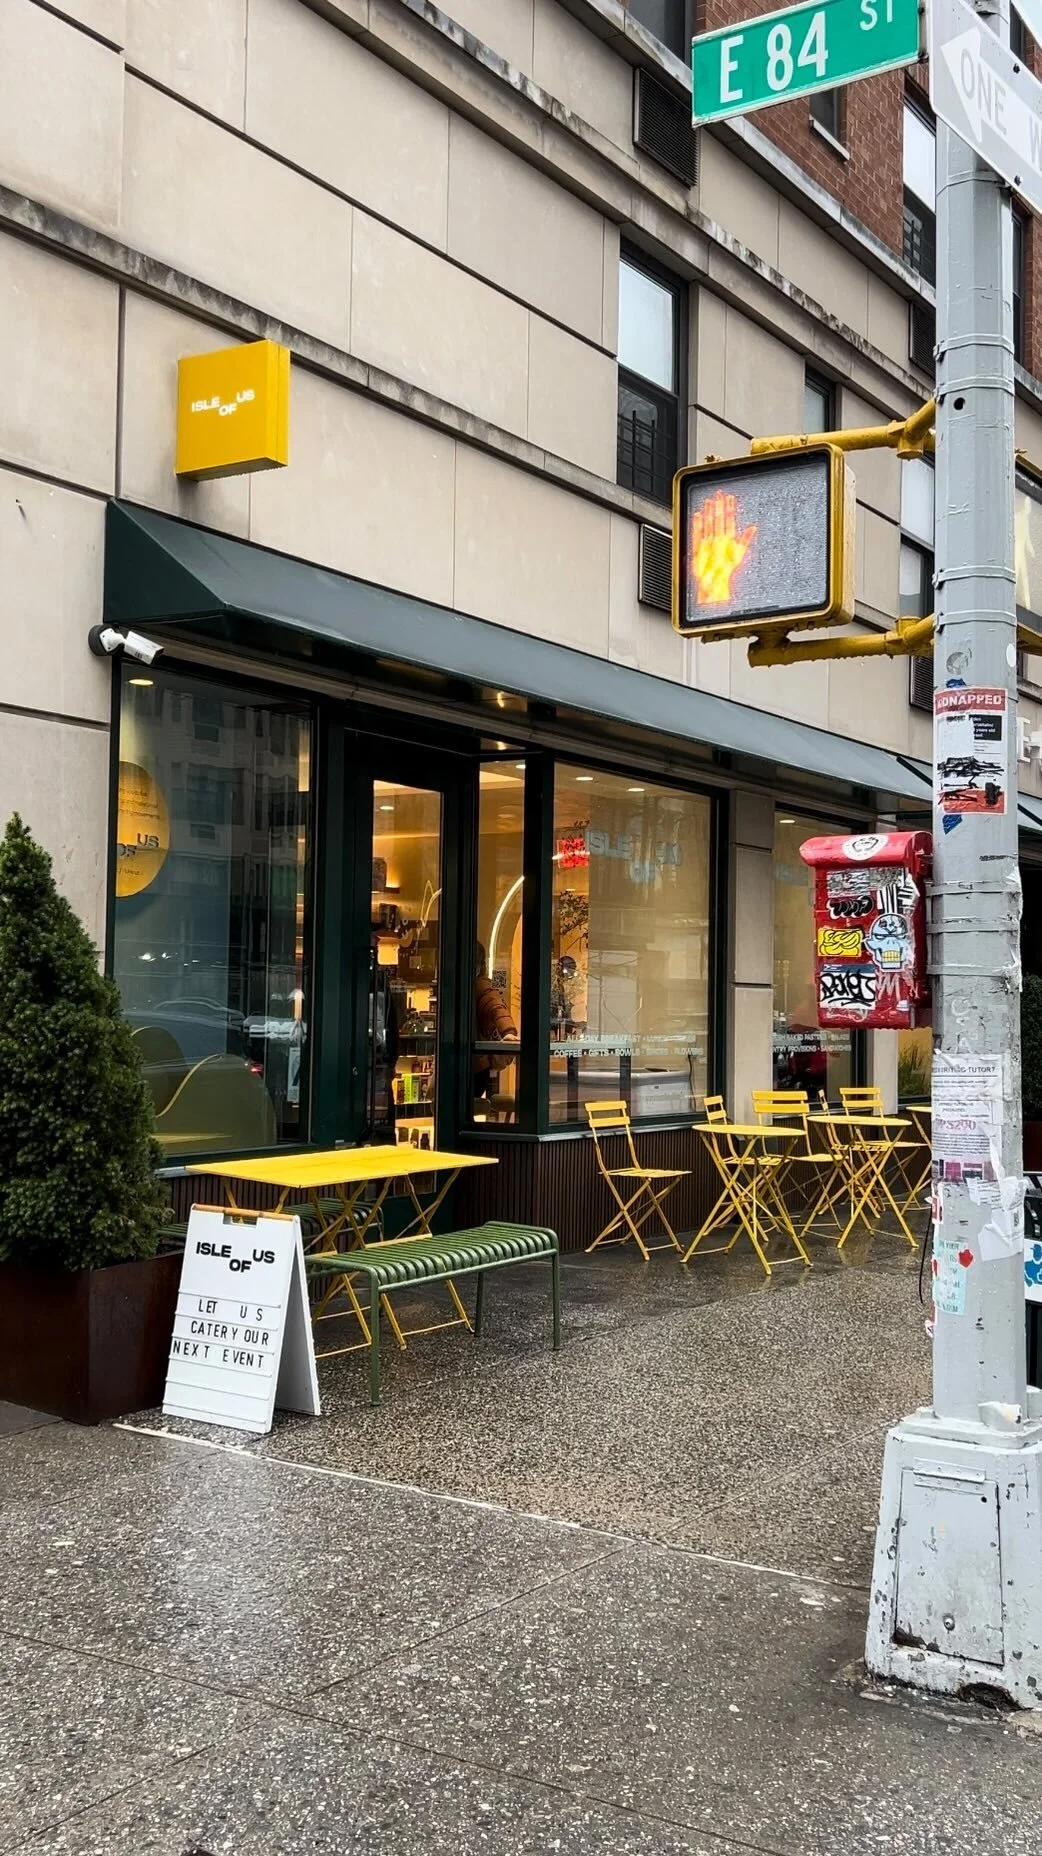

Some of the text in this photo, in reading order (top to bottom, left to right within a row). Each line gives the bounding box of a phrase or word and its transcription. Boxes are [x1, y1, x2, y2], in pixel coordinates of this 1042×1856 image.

[719, 34, 743, 104] E
[766, 11, 829, 91] 84
[961, 47, 1008, 136] ONE
[191, 388, 255, 417] ISLE OF US
[137, 832, 160, 849] US
[553, 1049, 583, 1058] COFFEE
[588, 1049, 610, 1057] GIFTS
[196, 1242, 275, 1273] ISLE OF US
[198, 1299, 218, 1314] LET
[190, 1320, 228, 1339] CATER
[173, 1340, 264, 1369] NEXT EVENT
